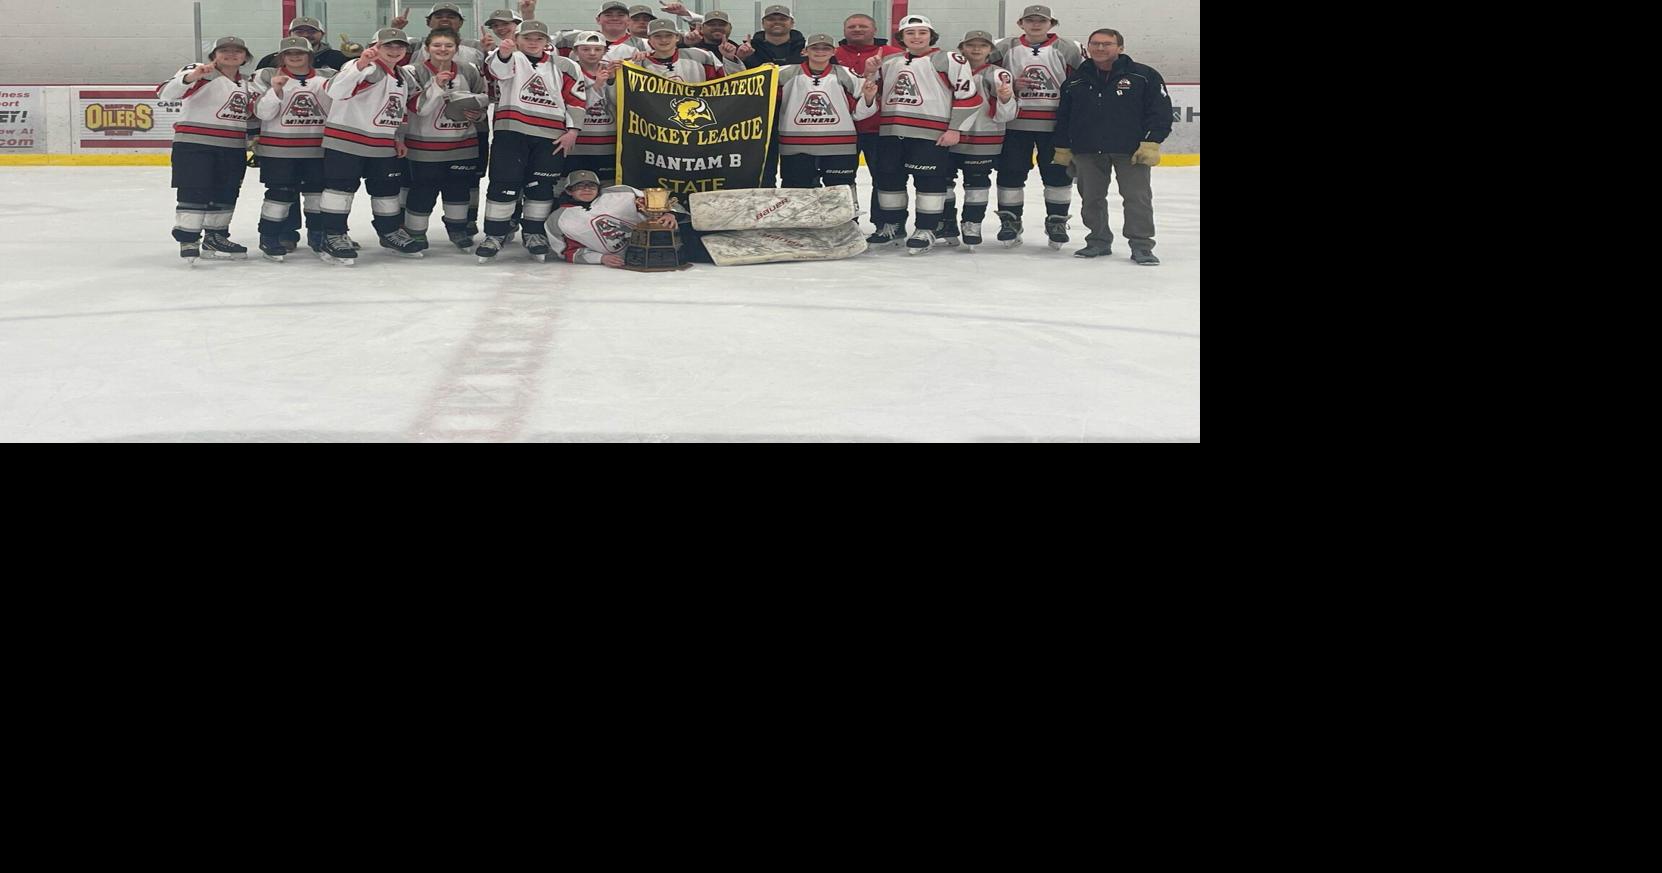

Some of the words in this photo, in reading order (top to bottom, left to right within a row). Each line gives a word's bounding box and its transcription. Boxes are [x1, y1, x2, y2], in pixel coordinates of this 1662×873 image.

[628, 70, 695, 97] WYOMING
[699, 74, 765, 97] AMATEUR
[86, 104, 153, 131] OILERS
[628, 110, 692, 145] HOCKEY
[697, 116, 763, 145] LEAGUE
[645, 150, 723, 171] BANTAM
[729, 153, 742, 167] B
[658, 177, 726, 193] STATE
[754, 197, 790, 221] BAUER
